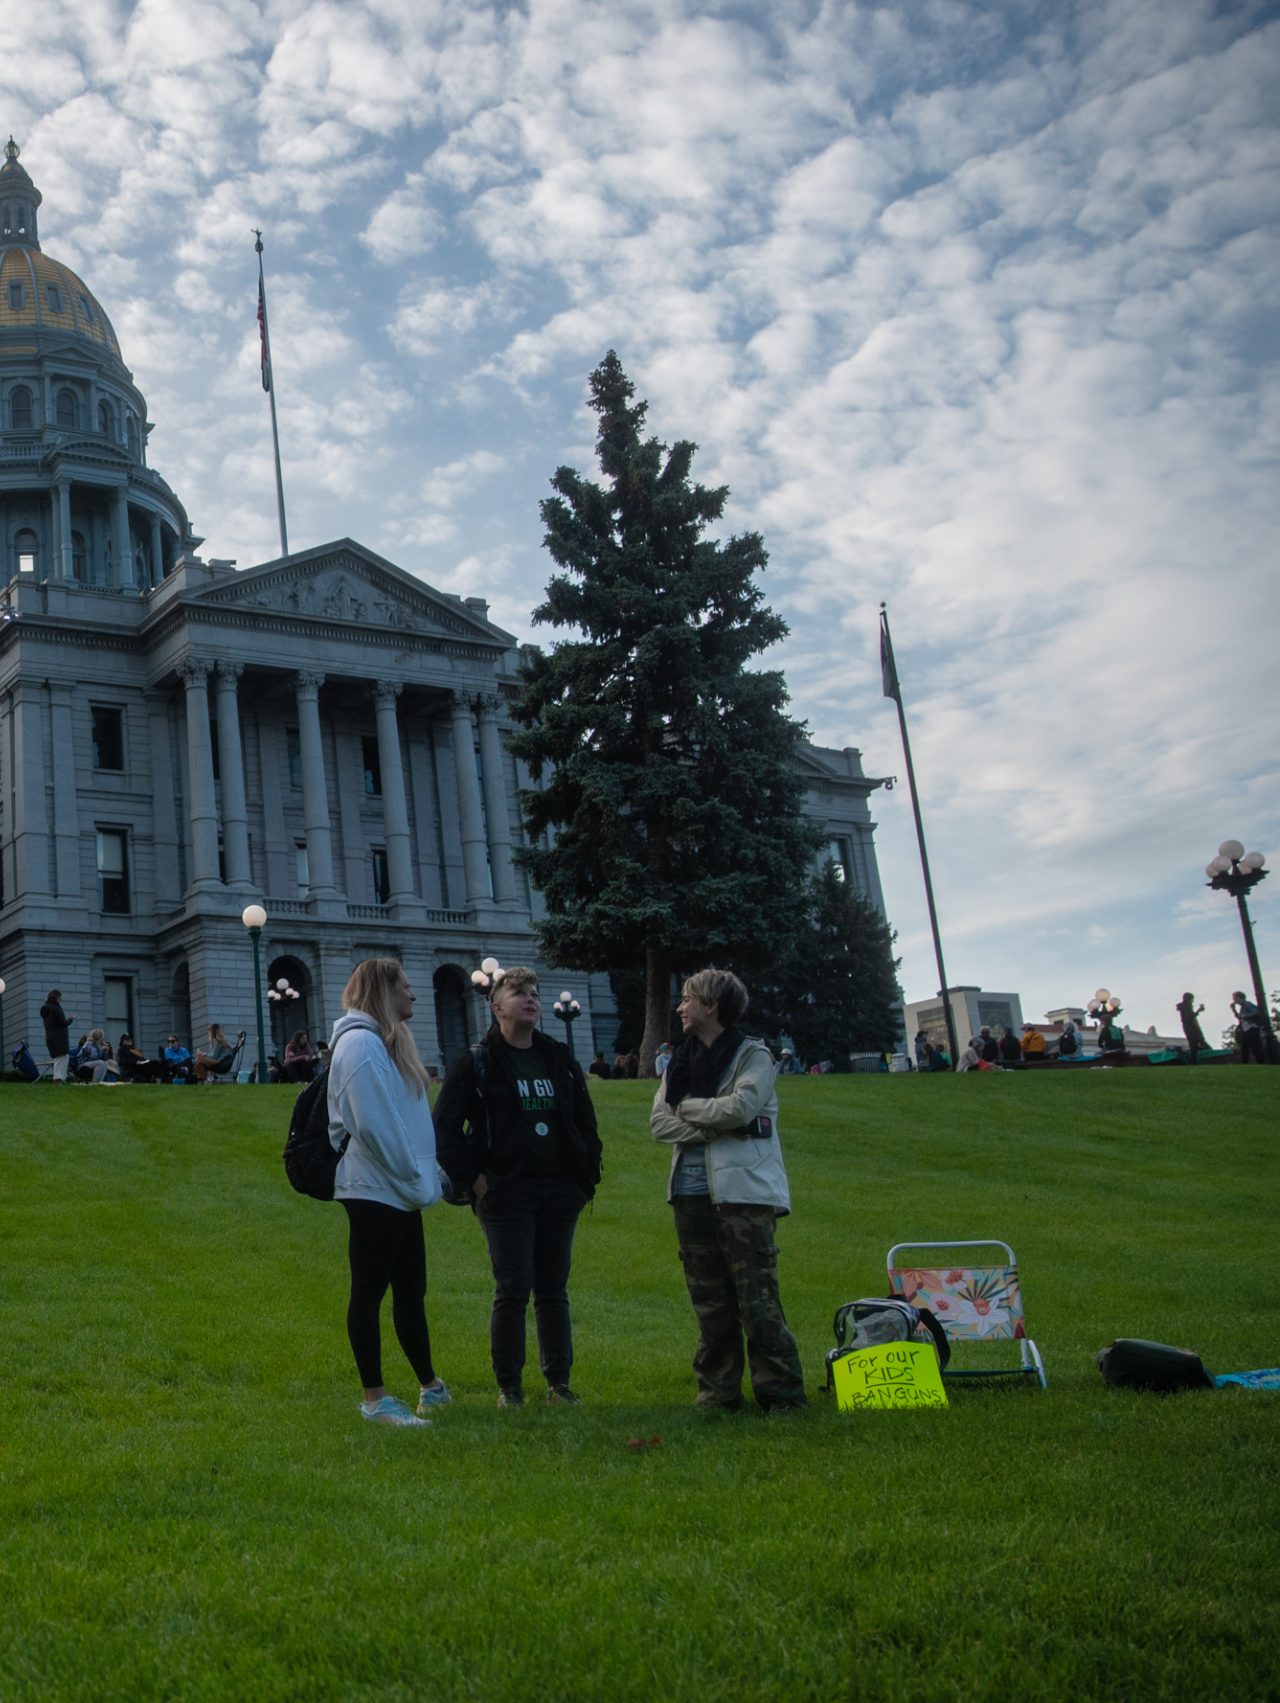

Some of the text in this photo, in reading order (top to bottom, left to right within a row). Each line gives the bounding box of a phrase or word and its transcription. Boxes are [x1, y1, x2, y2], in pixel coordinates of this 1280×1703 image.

[847, 1350, 920, 1375] For our
[864, 1366, 915, 1385] KIDS
